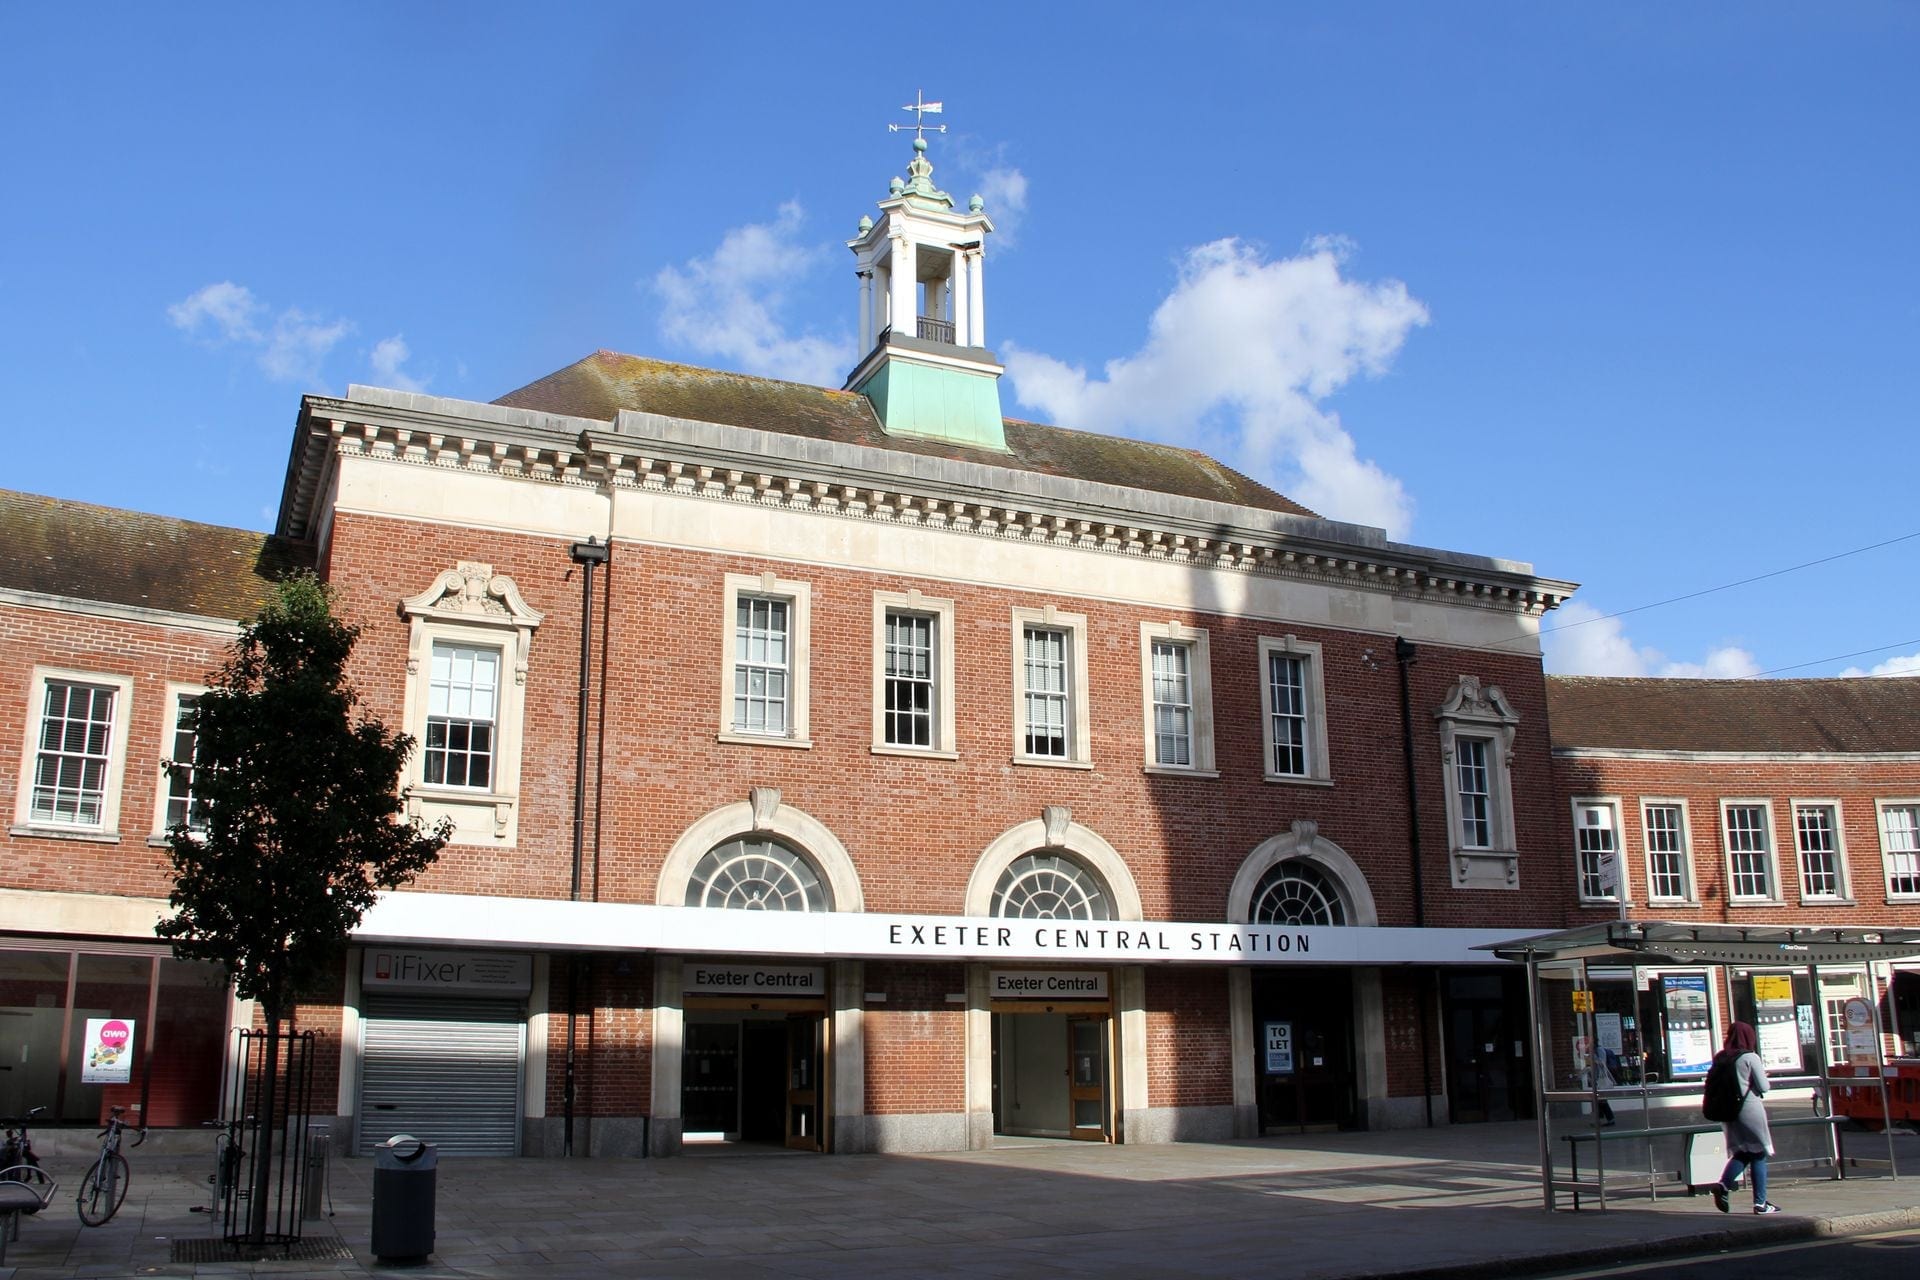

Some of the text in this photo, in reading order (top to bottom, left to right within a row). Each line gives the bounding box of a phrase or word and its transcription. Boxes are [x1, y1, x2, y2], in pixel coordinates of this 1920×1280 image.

[889, 924, 1310, 952] EXETER CENTRAL STATION
[394, 955, 466, 982] iFixer
[696, 970, 813, 987] Exeter Central
[997, 975, 1098, 990] Exeter Central
[103, 1030, 127, 1038] awe
[1270, 1027, 1287, 1037] TO
[1269, 1039, 1289, 1050] LET
